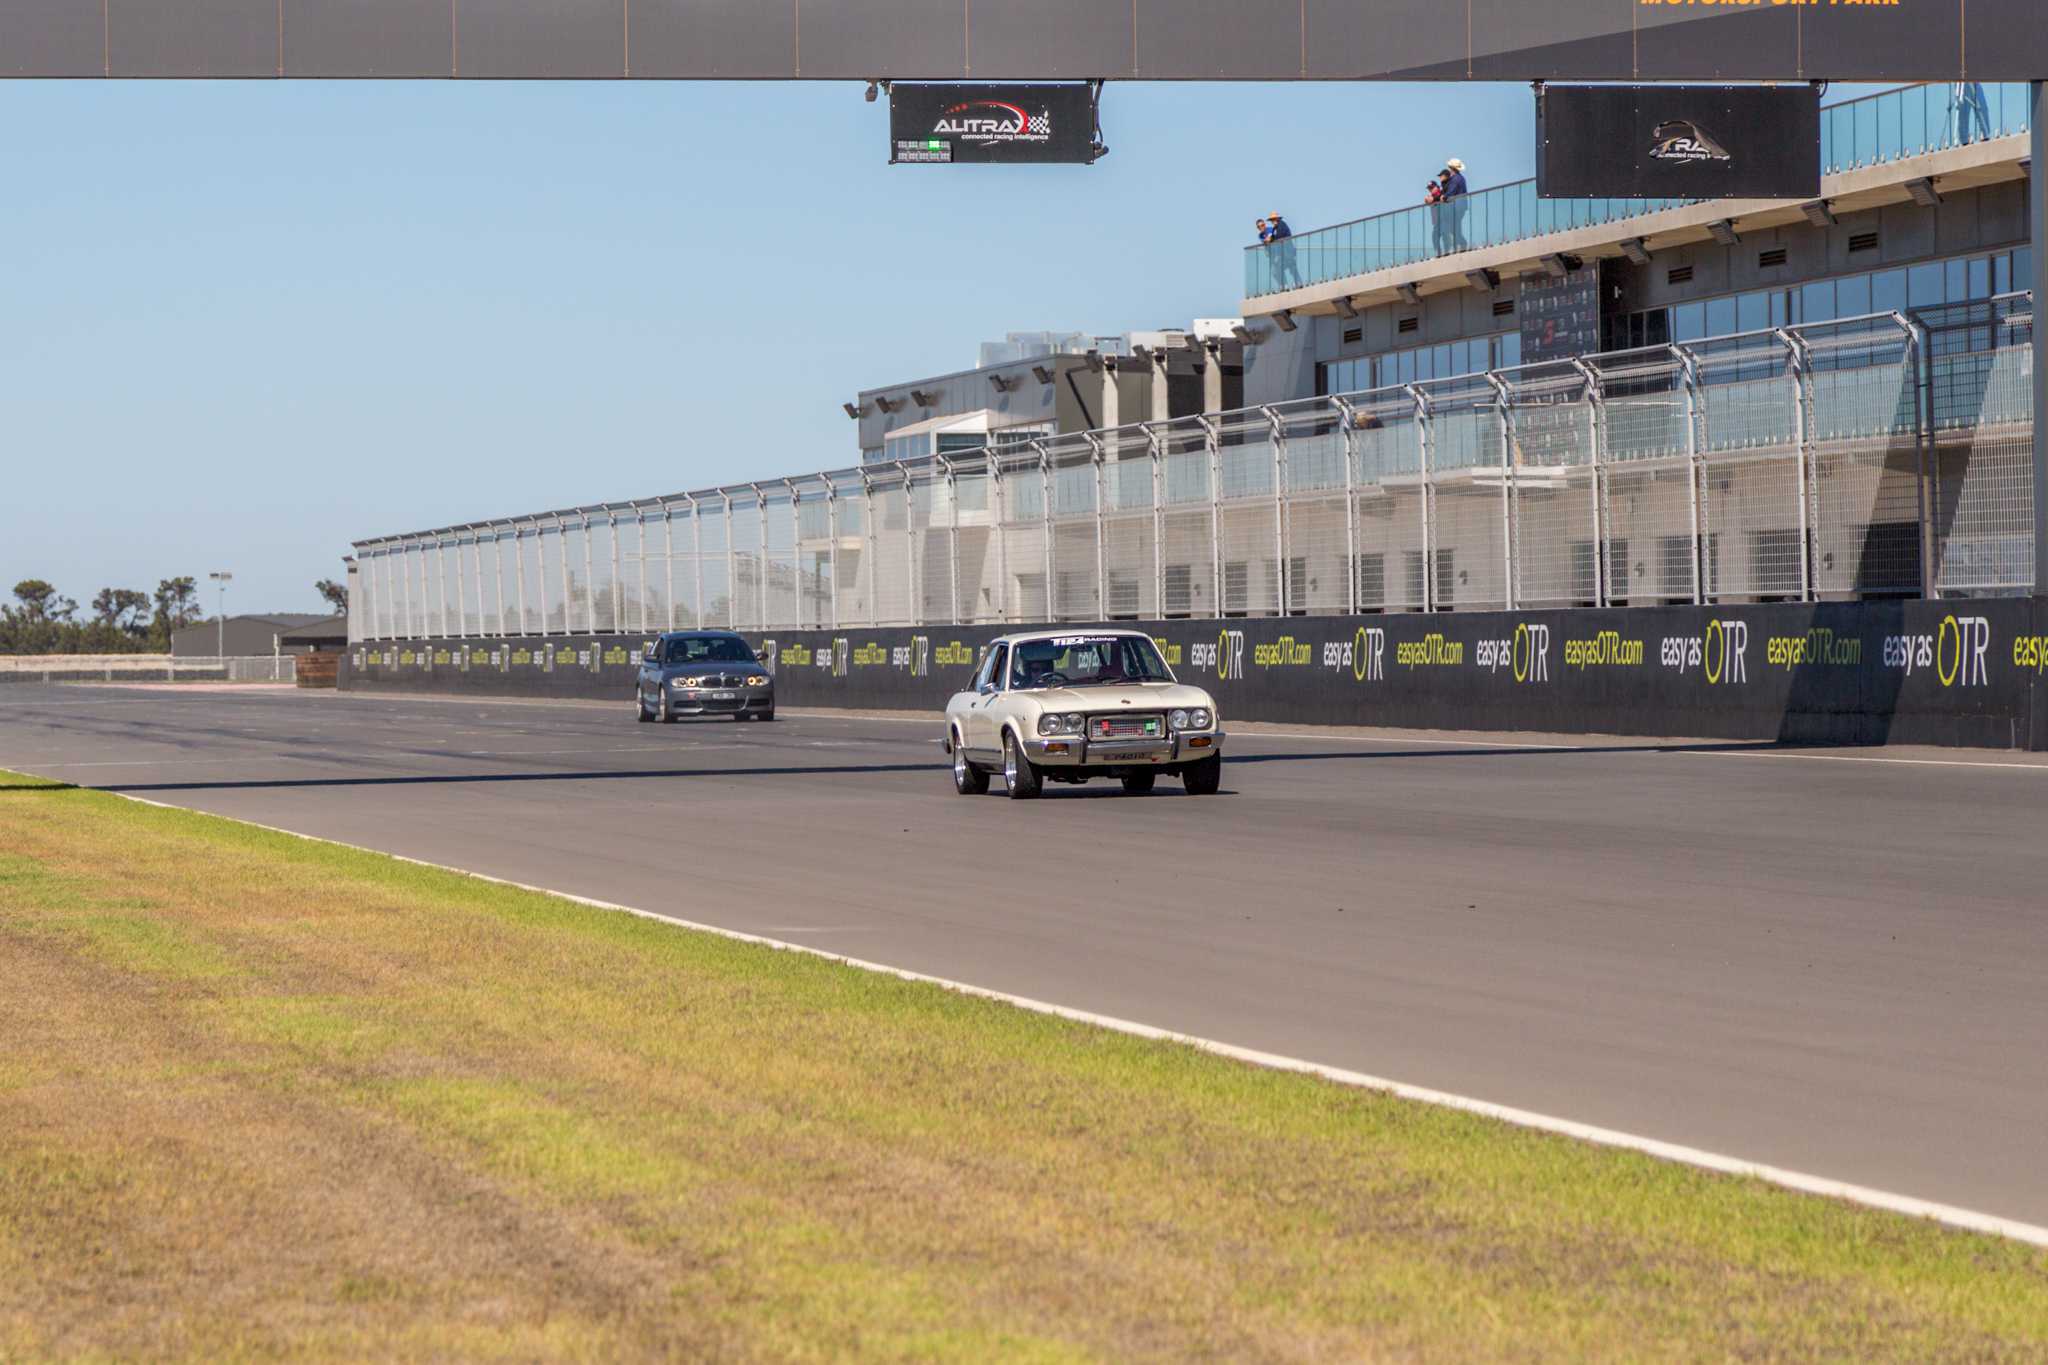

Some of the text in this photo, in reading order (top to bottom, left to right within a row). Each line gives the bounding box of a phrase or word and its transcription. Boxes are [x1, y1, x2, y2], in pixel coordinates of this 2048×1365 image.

[1015, 133, 1048, 141] intelligence
[911, 635, 928, 677] OTR
[1191, 629, 1244, 680] easy as OTR
[1254, 636, 1312, 671] easyasOTR.com
[1323, 626, 1385, 681] easy as OTR
[1397, 633, 1463, 671] easyasOTR.com
[1476, 623, 1549, 682] easy as OTR
[1565, 630, 1643, 671] easyasOTR.com
[1661, 619, 1748, 684] easy as OTR
[1767, 627, 1861, 672] easyasOTR.com
[1883, 615, 1990, 687] easy as OTR
